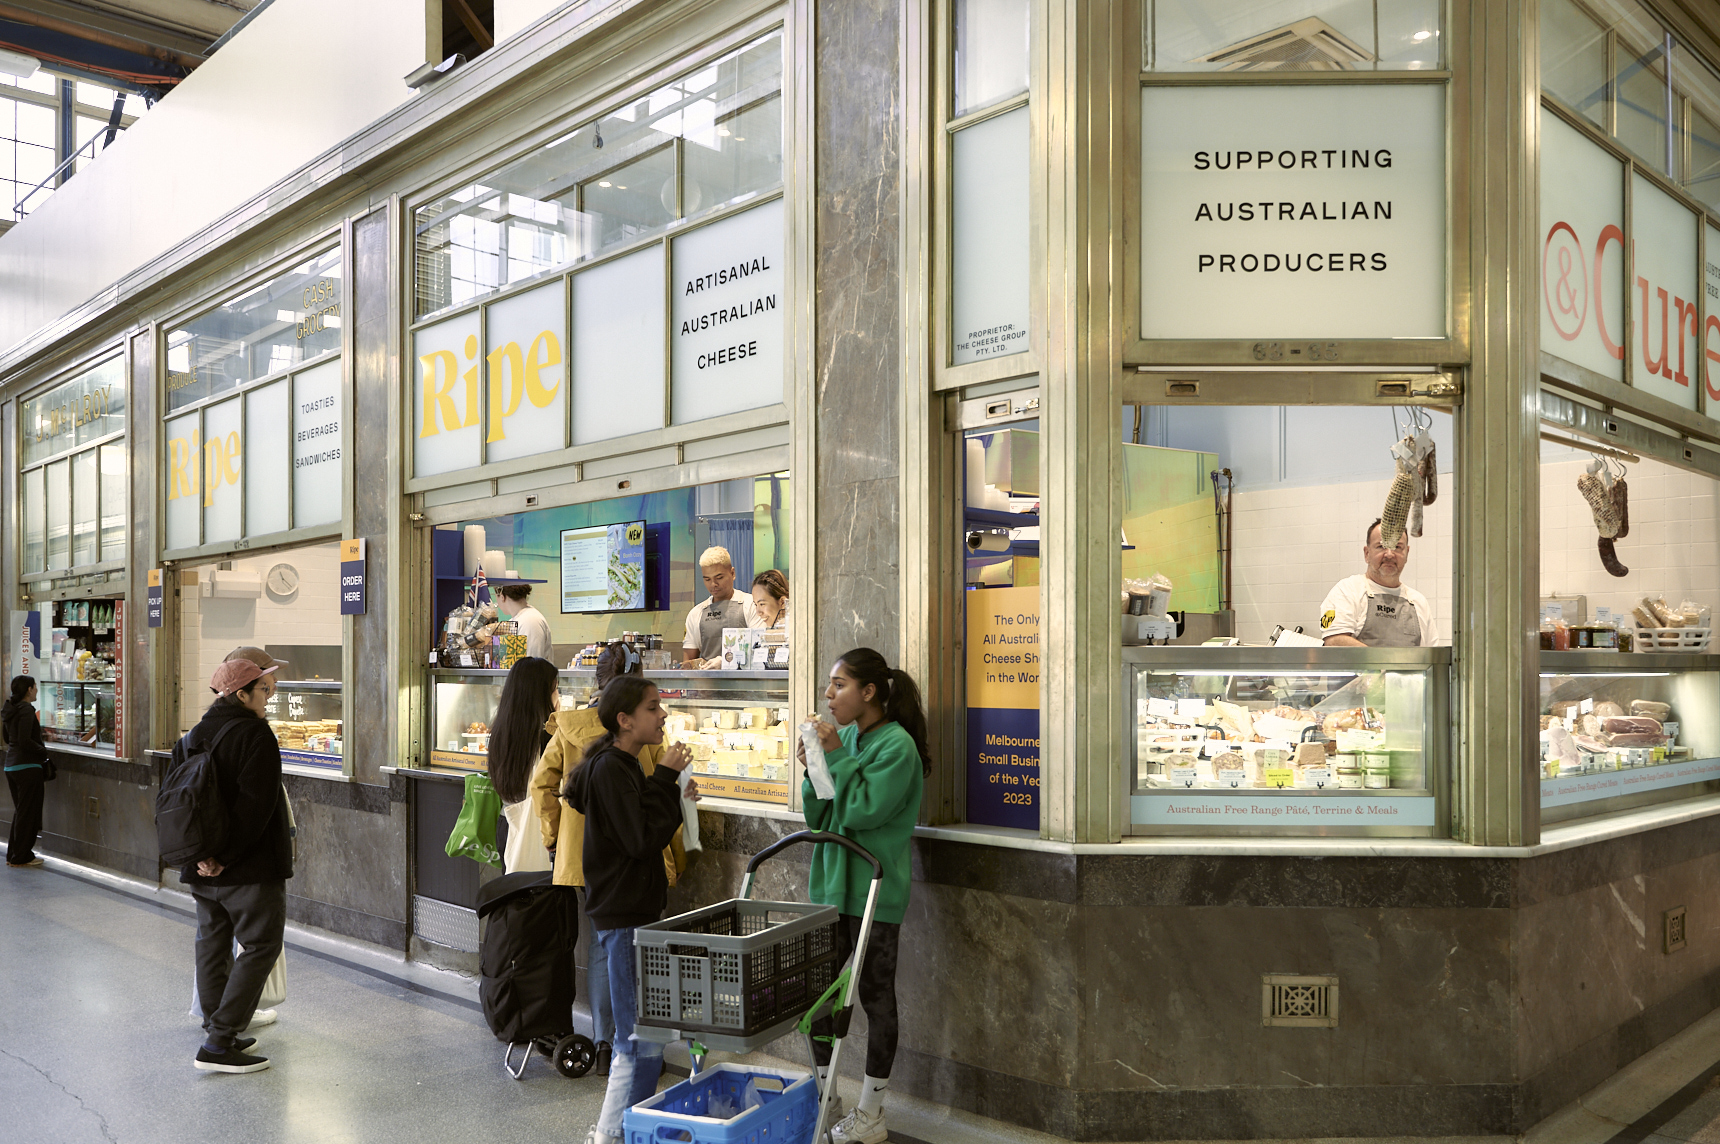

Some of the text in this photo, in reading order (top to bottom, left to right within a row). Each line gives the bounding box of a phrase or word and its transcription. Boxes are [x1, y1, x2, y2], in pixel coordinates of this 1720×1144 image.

[1194, 149, 1392, 170] SUPPORTING
[1194, 201, 1392, 221] AUSTRALIAN
[1198, 253, 1387, 272] PRODUCERS
[685, 256, 770, 296] ARTISANAL
[303, 277, 334, 309] CASH
[681, 294, 776, 336] AUSTRALIAN
[968, 324, 1016, 340] PROPRIETOR:
[956, 330, 1026, 351] THE CHEESE GROUP
[697, 340, 757, 370] CHEESE
[976, 344, 1008, 356] PTY. LTD.
[168, 365, 198, 393] PRODUCE
[418, 329, 562, 444] Ripe
[302, 396, 334, 415] TOASTIES
[298, 422, 339, 442] BEVERAGES
[295, 448, 341, 469] SANDWICHES
[168, 428, 241, 507] Ripe
[628, 530, 642, 540] NEW
[342, 576, 363, 586] ORDER
[344, 592, 361, 602] HERE
[1376, 604, 1396, 614] Ripe
[994, 614, 1040, 626] The Only
[983, 632, 1040, 645] All Australi
[983, 653, 1021, 664] Cheese
[986, 672, 1040, 683] in the Wor
[986, 734, 1040, 748] Melbourne
[979, 753, 1040, 767] Small Busin
[989, 772, 1000, 784] of
[1002, 773, 1019, 785] the
[1558, 785, 1577, 795] Australian
[1578, 784, 1586, 793] Free
[1586, 782, 1596, 791] Range
[1597, 781, 1607, 790] Cured
[1608, 779, 1618, 788] Meats
[1623, 775, 1639, 784] Australian
[1646, 774, 1656, 782] Range
[1656, 772, 1665, 780] Cured
[696, 781, 708, 790] sanal
[709, 783, 725, 791] Cheese
[742, 787, 767, 795] Australian
[1003, 792, 1032, 806] 2023
[1166, 804, 1398, 817] Australian Free Range Pâté, Terrine & Meals
